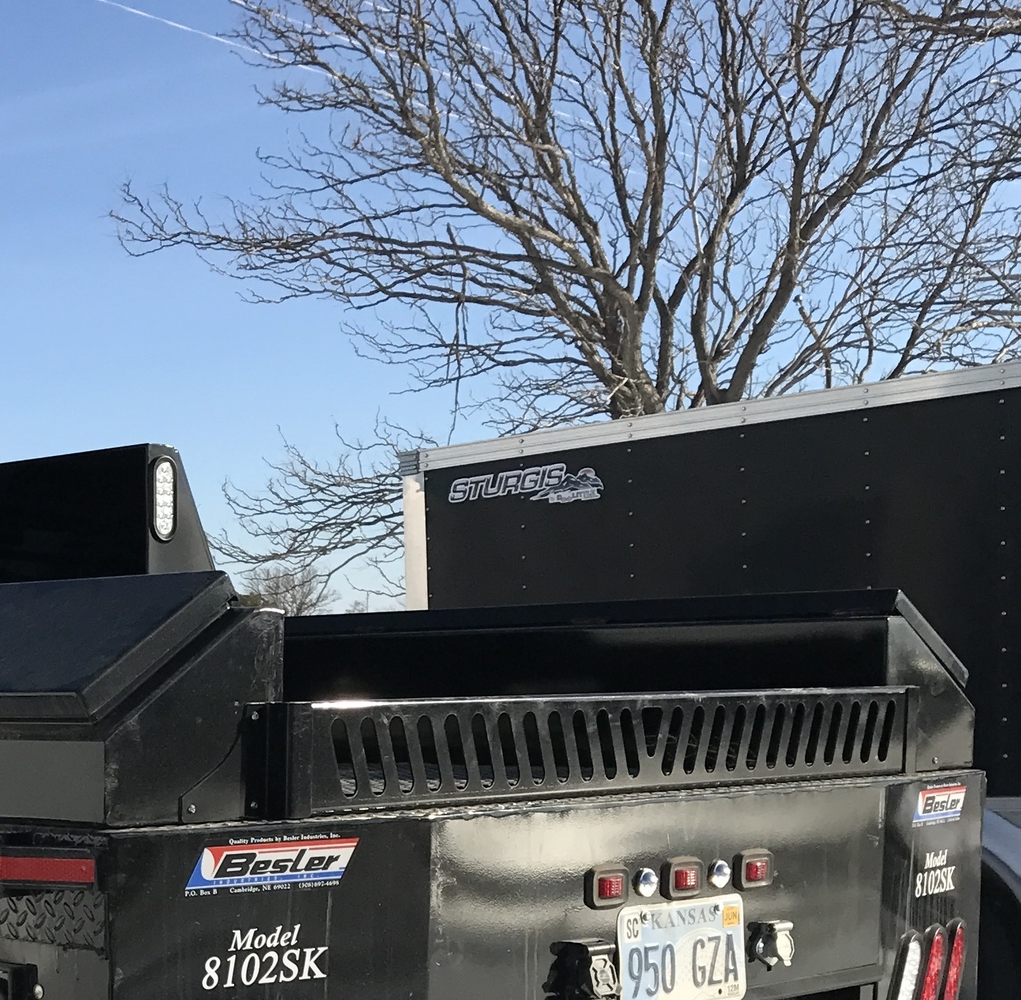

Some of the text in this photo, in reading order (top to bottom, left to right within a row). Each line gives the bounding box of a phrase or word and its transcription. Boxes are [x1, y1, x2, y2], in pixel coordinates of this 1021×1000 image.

[449, 463, 566, 503] STURGIS
[922, 794, 961, 814] Besler
[213, 848, 341, 879] Besler
[924, 849, 948, 869] Model
[915, 866, 956, 898] 8102SK
[626, 917, 639, 939] SC
[651, 906, 717, 931] KANSAS
[724, 911, 738, 921] JUN
[228, 924, 301, 951] Model
[202, 946, 329, 990] 8102SK
[628, 932, 739, 999] 950 GZA
